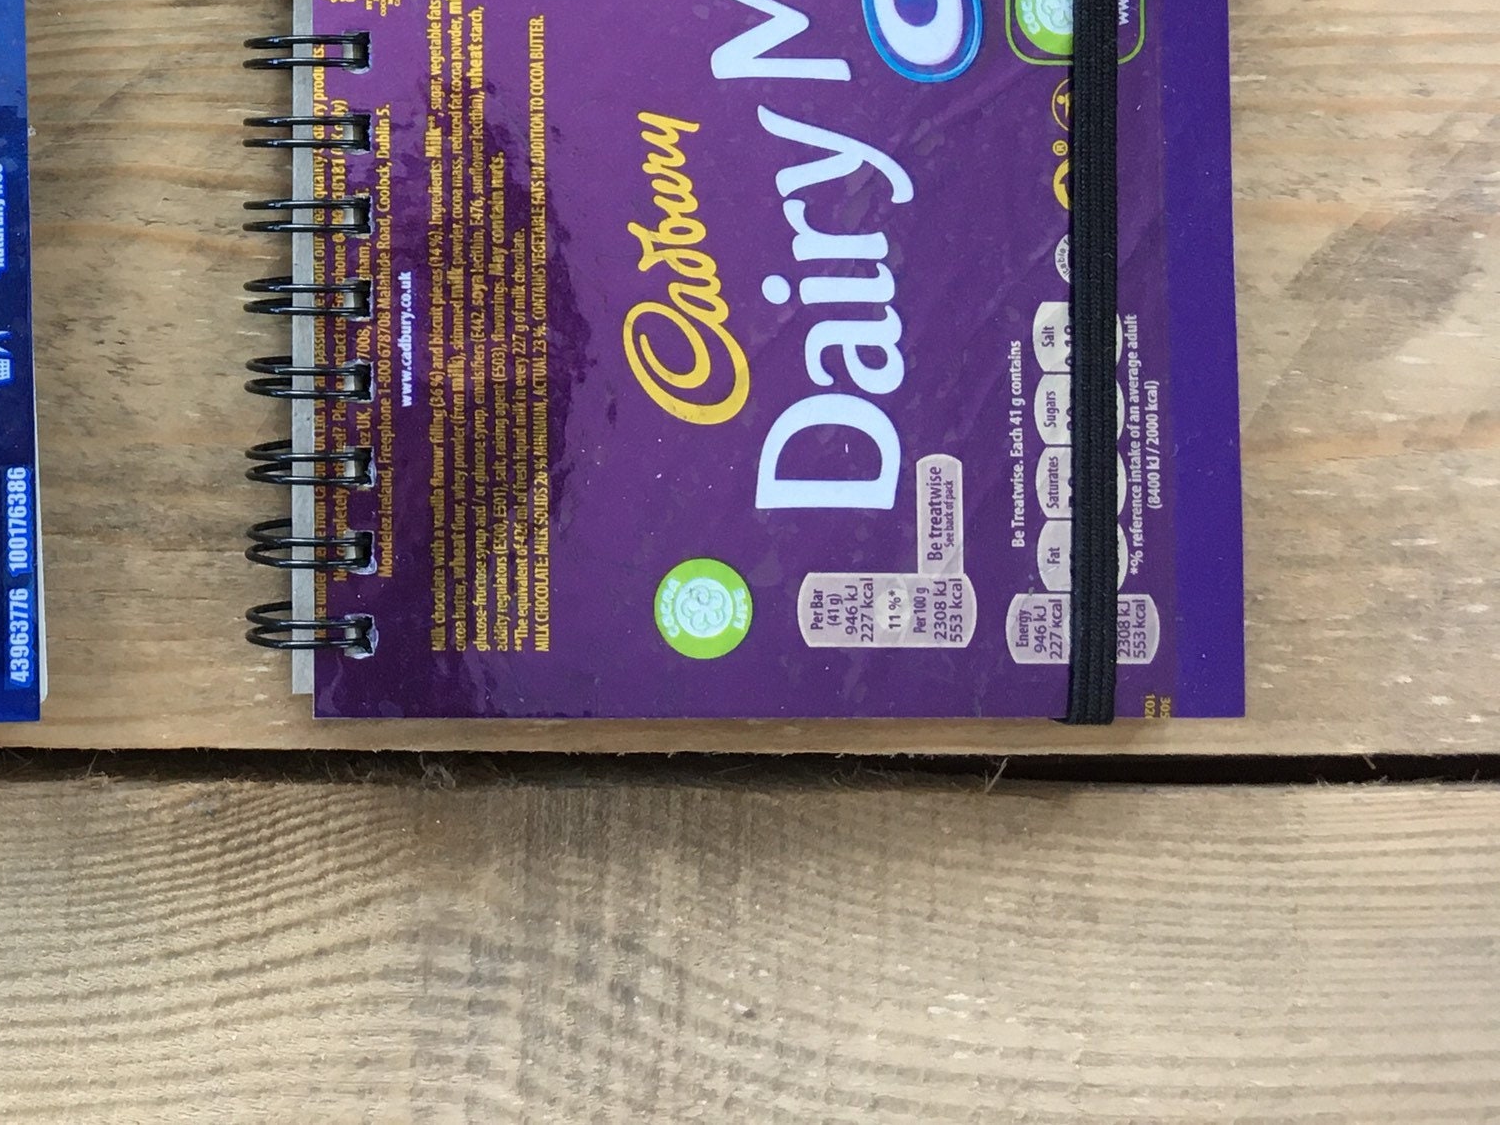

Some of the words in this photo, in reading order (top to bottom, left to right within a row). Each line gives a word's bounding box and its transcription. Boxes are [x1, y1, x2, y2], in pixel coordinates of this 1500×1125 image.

[622, 112, 751, 425] Cadbury
[755, 105, 914, 509] Dairy
[397, 271, 416, 407] www.cadbury.co.uk
[1041, 326, 1055, 347] Salt
[1008, 340, 1022, 395] contains
[1009, 410, 1022, 425] 41
[1012, 398, 1026, 406] g
[1043, 391, 1060, 428] Sugars
[1009, 428, 1023, 457] Each
[1010, 460, 1025, 528] Treatwise.
[1046, 456, 1059, 509] Saturates
[926, 467, 944, 539] treatwise
[6, 467, 33, 576] 100176386
[927, 542, 943, 561] Be
[1012, 530, 1025, 547] Be
[1046, 547, 1060, 567] Fat
[810, 589, 824, 609] Bar
[844, 585, 858, 602] kJ
[860, 578, 874, 611] kcal
[810, 611, 824, 630] Per
[845, 603, 859, 635] 946
[860, 613, 874, 642] 227
[9, 586, 33, 685] 43963776
